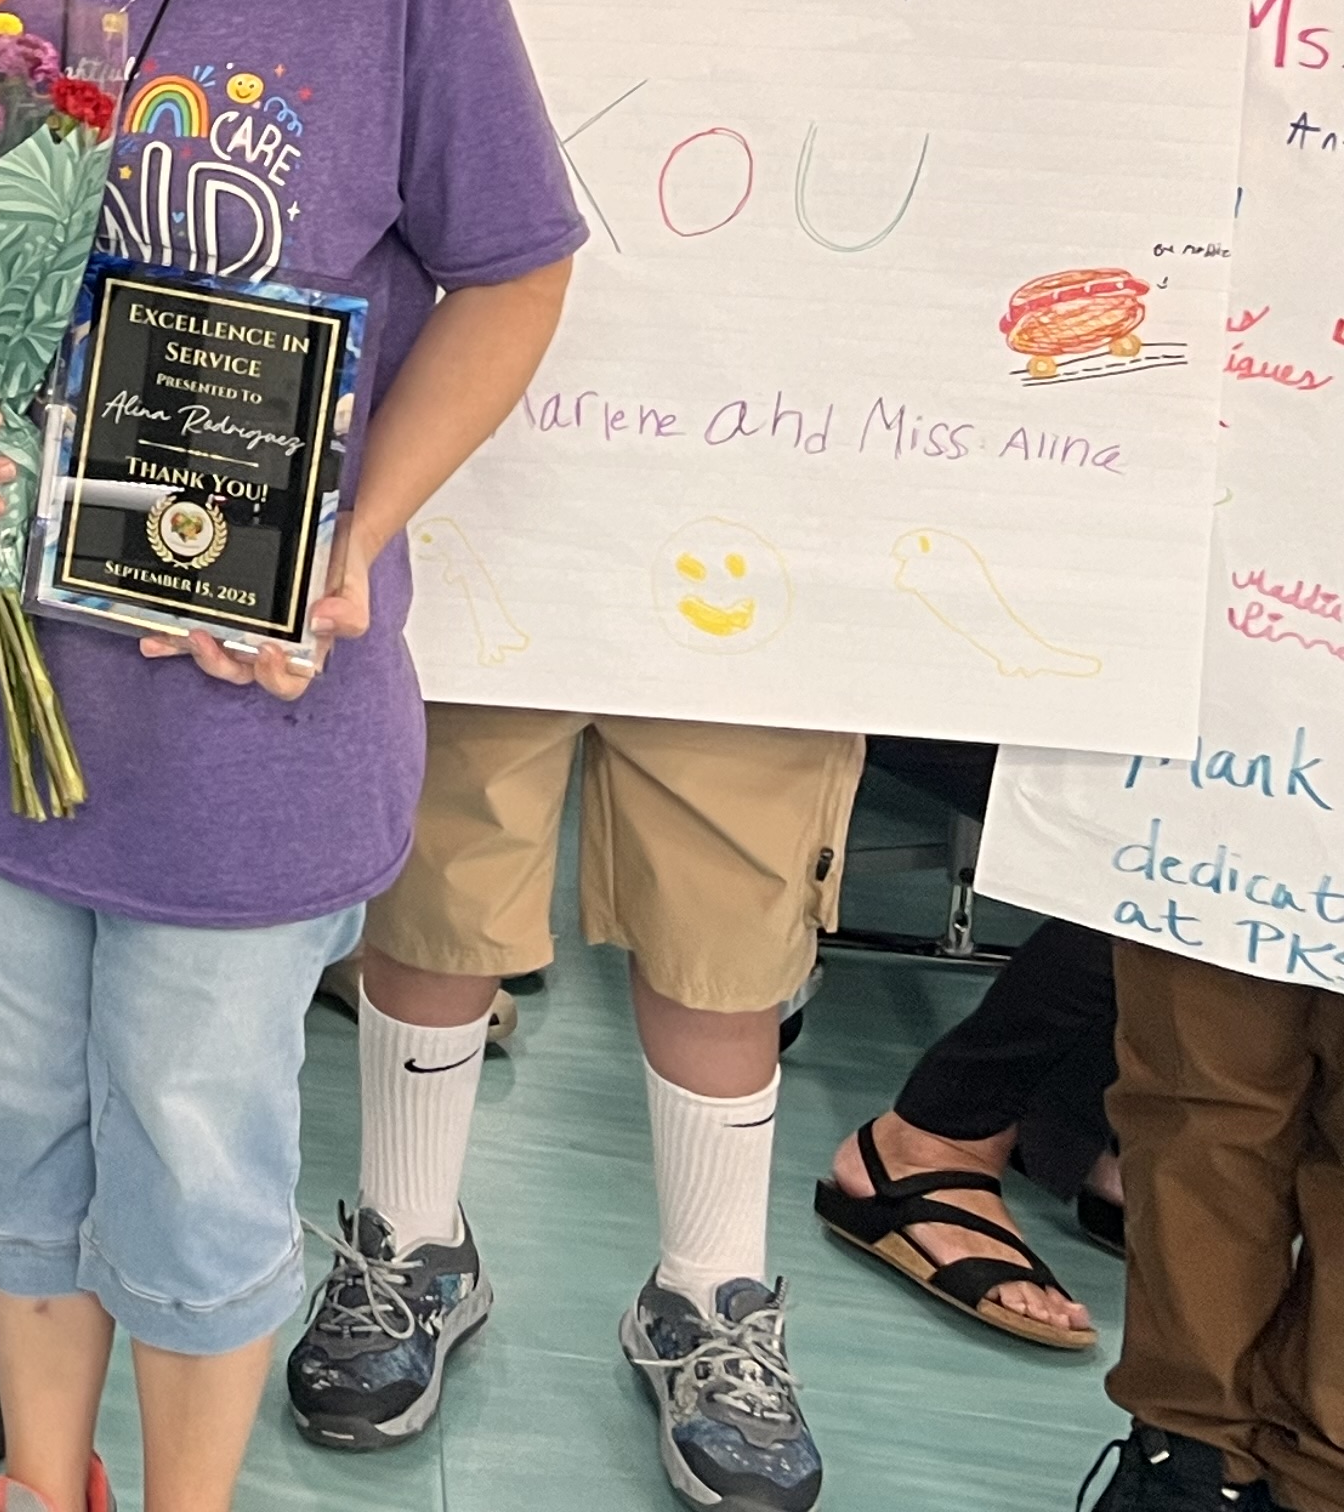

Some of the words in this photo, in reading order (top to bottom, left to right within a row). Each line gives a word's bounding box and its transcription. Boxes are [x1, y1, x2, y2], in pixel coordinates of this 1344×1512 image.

[209, 110, 302, 187] CARE
[95, 140, 283, 284] ND
[128, 303, 276, 350] EXCELLENCE
[282, 333, 310, 355] IN
[164, 341, 262, 378] SERVICE
[156, 372, 238, 401] PRESENTED
[100, 389, 171, 424] Alina
[177, 403, 306, 457] Rodriguez
[703, 391, 836, 456] and
[997, 426, 1129, 476] Alina
[124, 455, 204, 490] THANK
[211, 473, 269, 503] YOU!
[104, 559, 192, 594] SEPTEMBER
[217, 586, 257, 607] 2025
[1123, 726, 1334, 812] ank
[1112, 898, 1203, 948] at
[1236, 917, 1344, 983] PK
